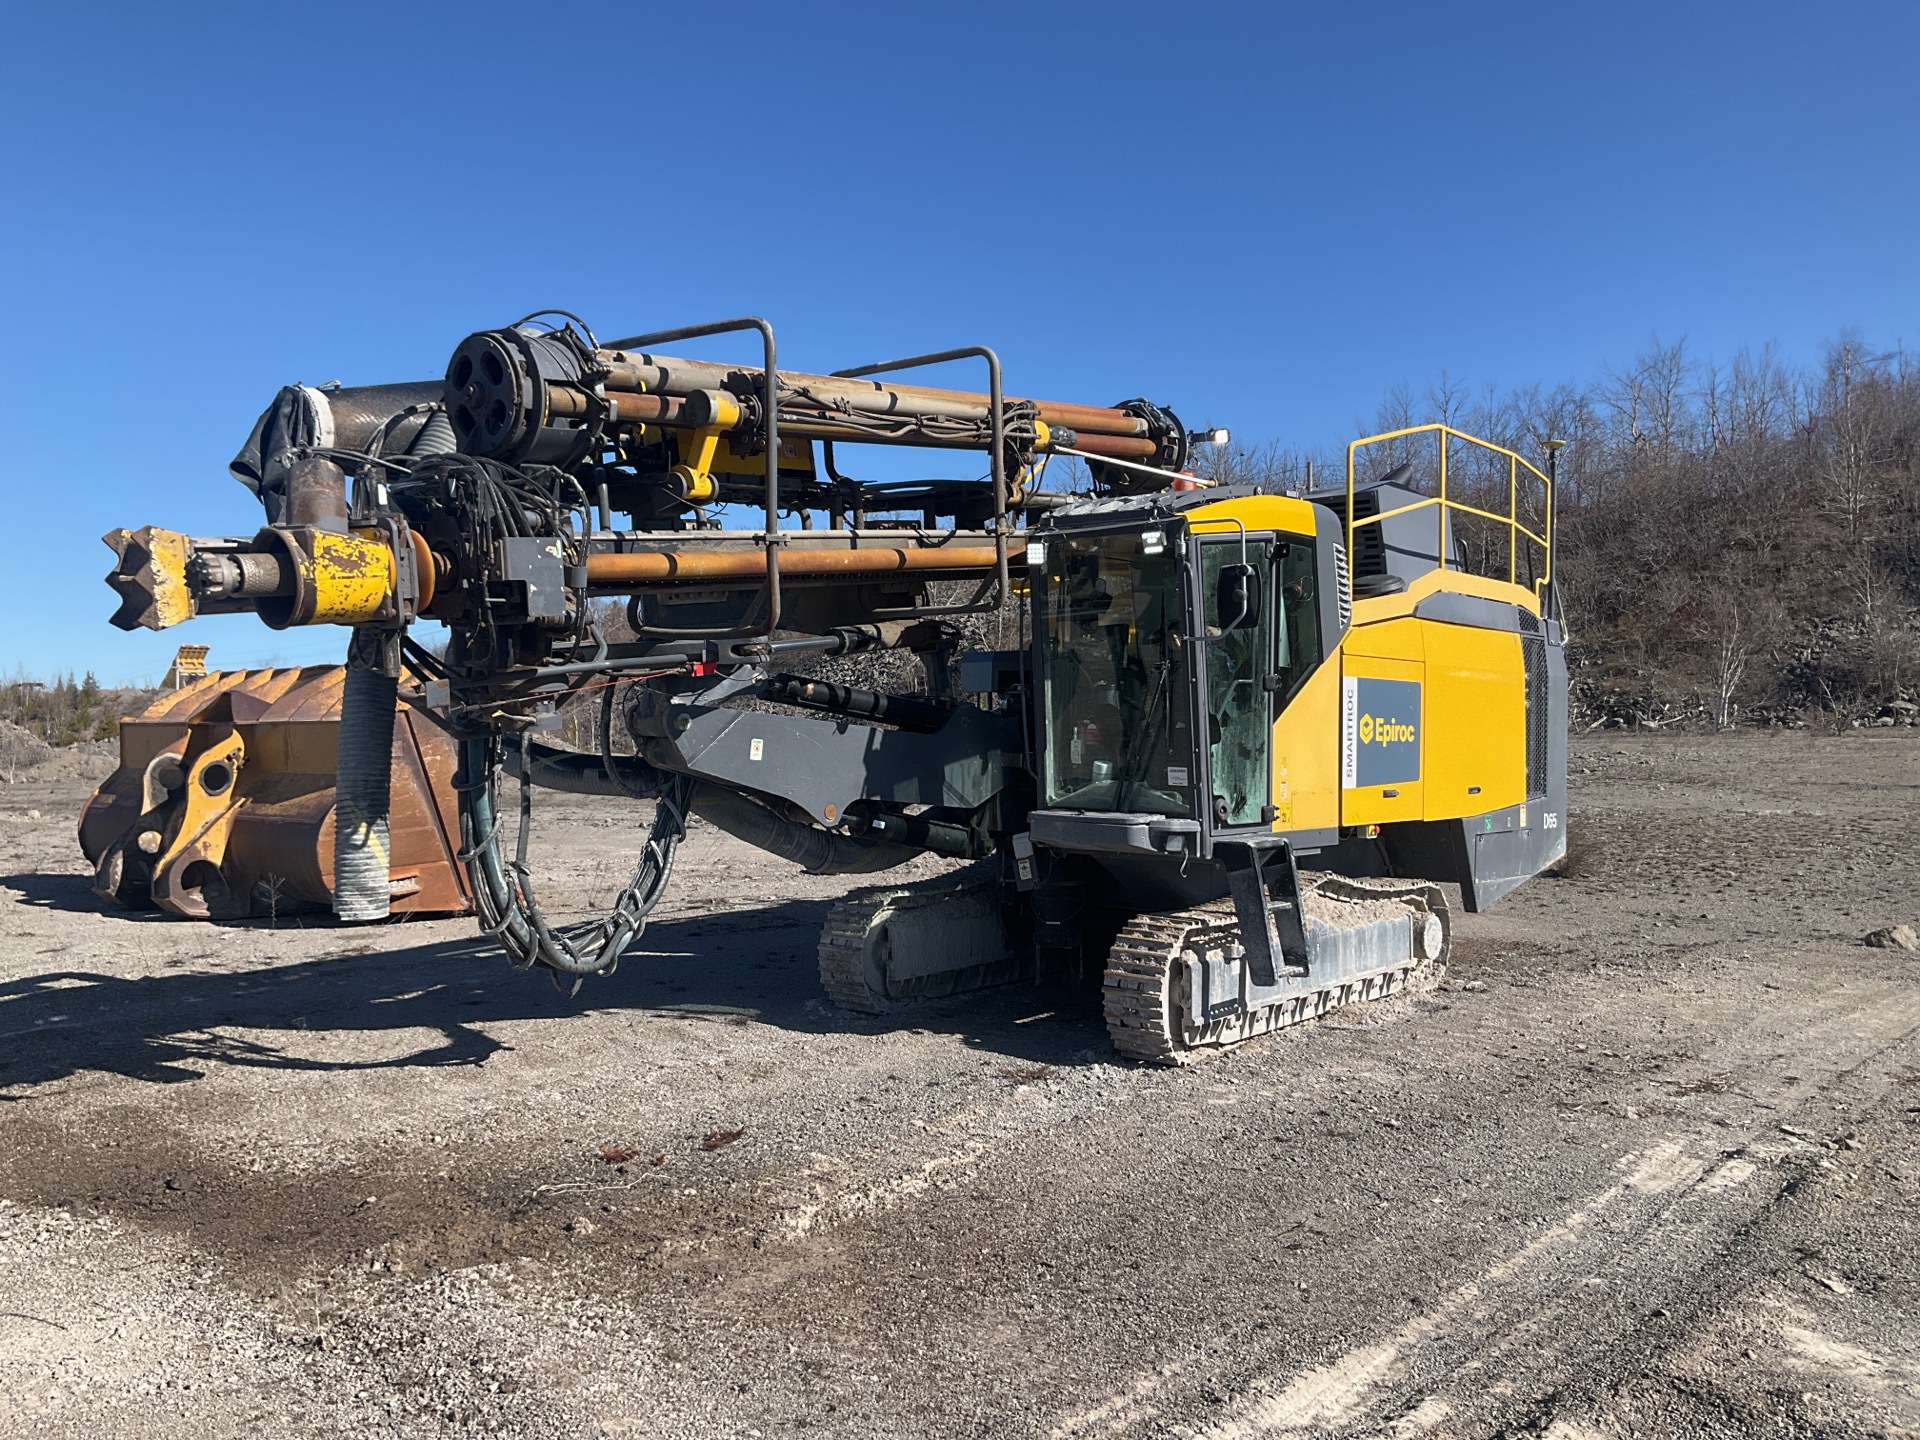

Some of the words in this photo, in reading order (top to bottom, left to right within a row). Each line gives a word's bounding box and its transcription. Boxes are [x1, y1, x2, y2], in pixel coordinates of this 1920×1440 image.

[1346, 689, 1354, 778] SMARTROC
[1375, 717, 1415, 748] Epiroc
[1543, 812, 1557, 829] D65
